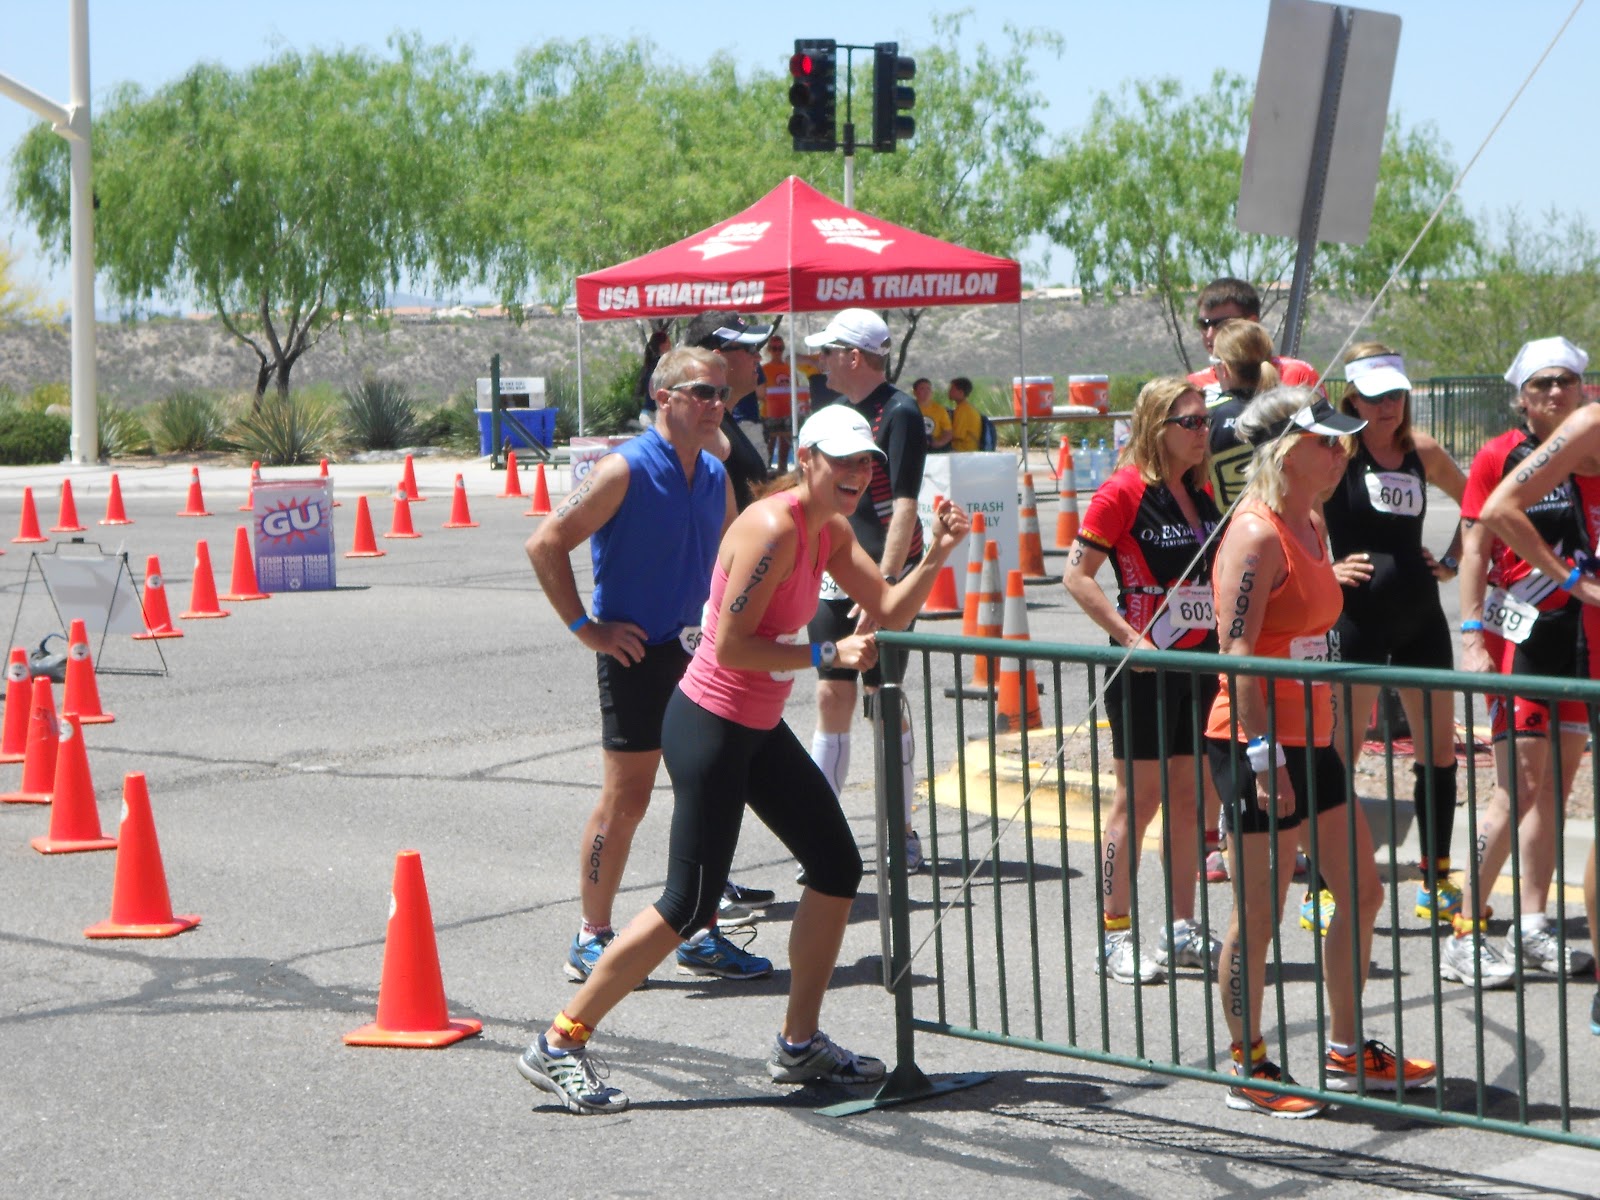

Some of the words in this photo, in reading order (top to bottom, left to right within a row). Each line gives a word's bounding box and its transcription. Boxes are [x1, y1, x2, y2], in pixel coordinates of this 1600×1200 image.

[598, 286, 640, 312] USA
[645, 280, 765, 307] TRIATHLON
[816, 277, 865, 302] USA
[872, 272, 998, 300] TRIATHLON
[966, 501, 1005, 514] TRASH
[1380, 486, 1414, 508] 601
[262, 503, 321, 537] GU
[729, 555, 773, 614] 578
[1180, 601, 1213, 621] 603
[1228, 571, 1256, 639] 598
[1484, 603, 1523, 631] 599
[588, 834, 605, 885] 564
[1103, 842, 1116, 897] 603
